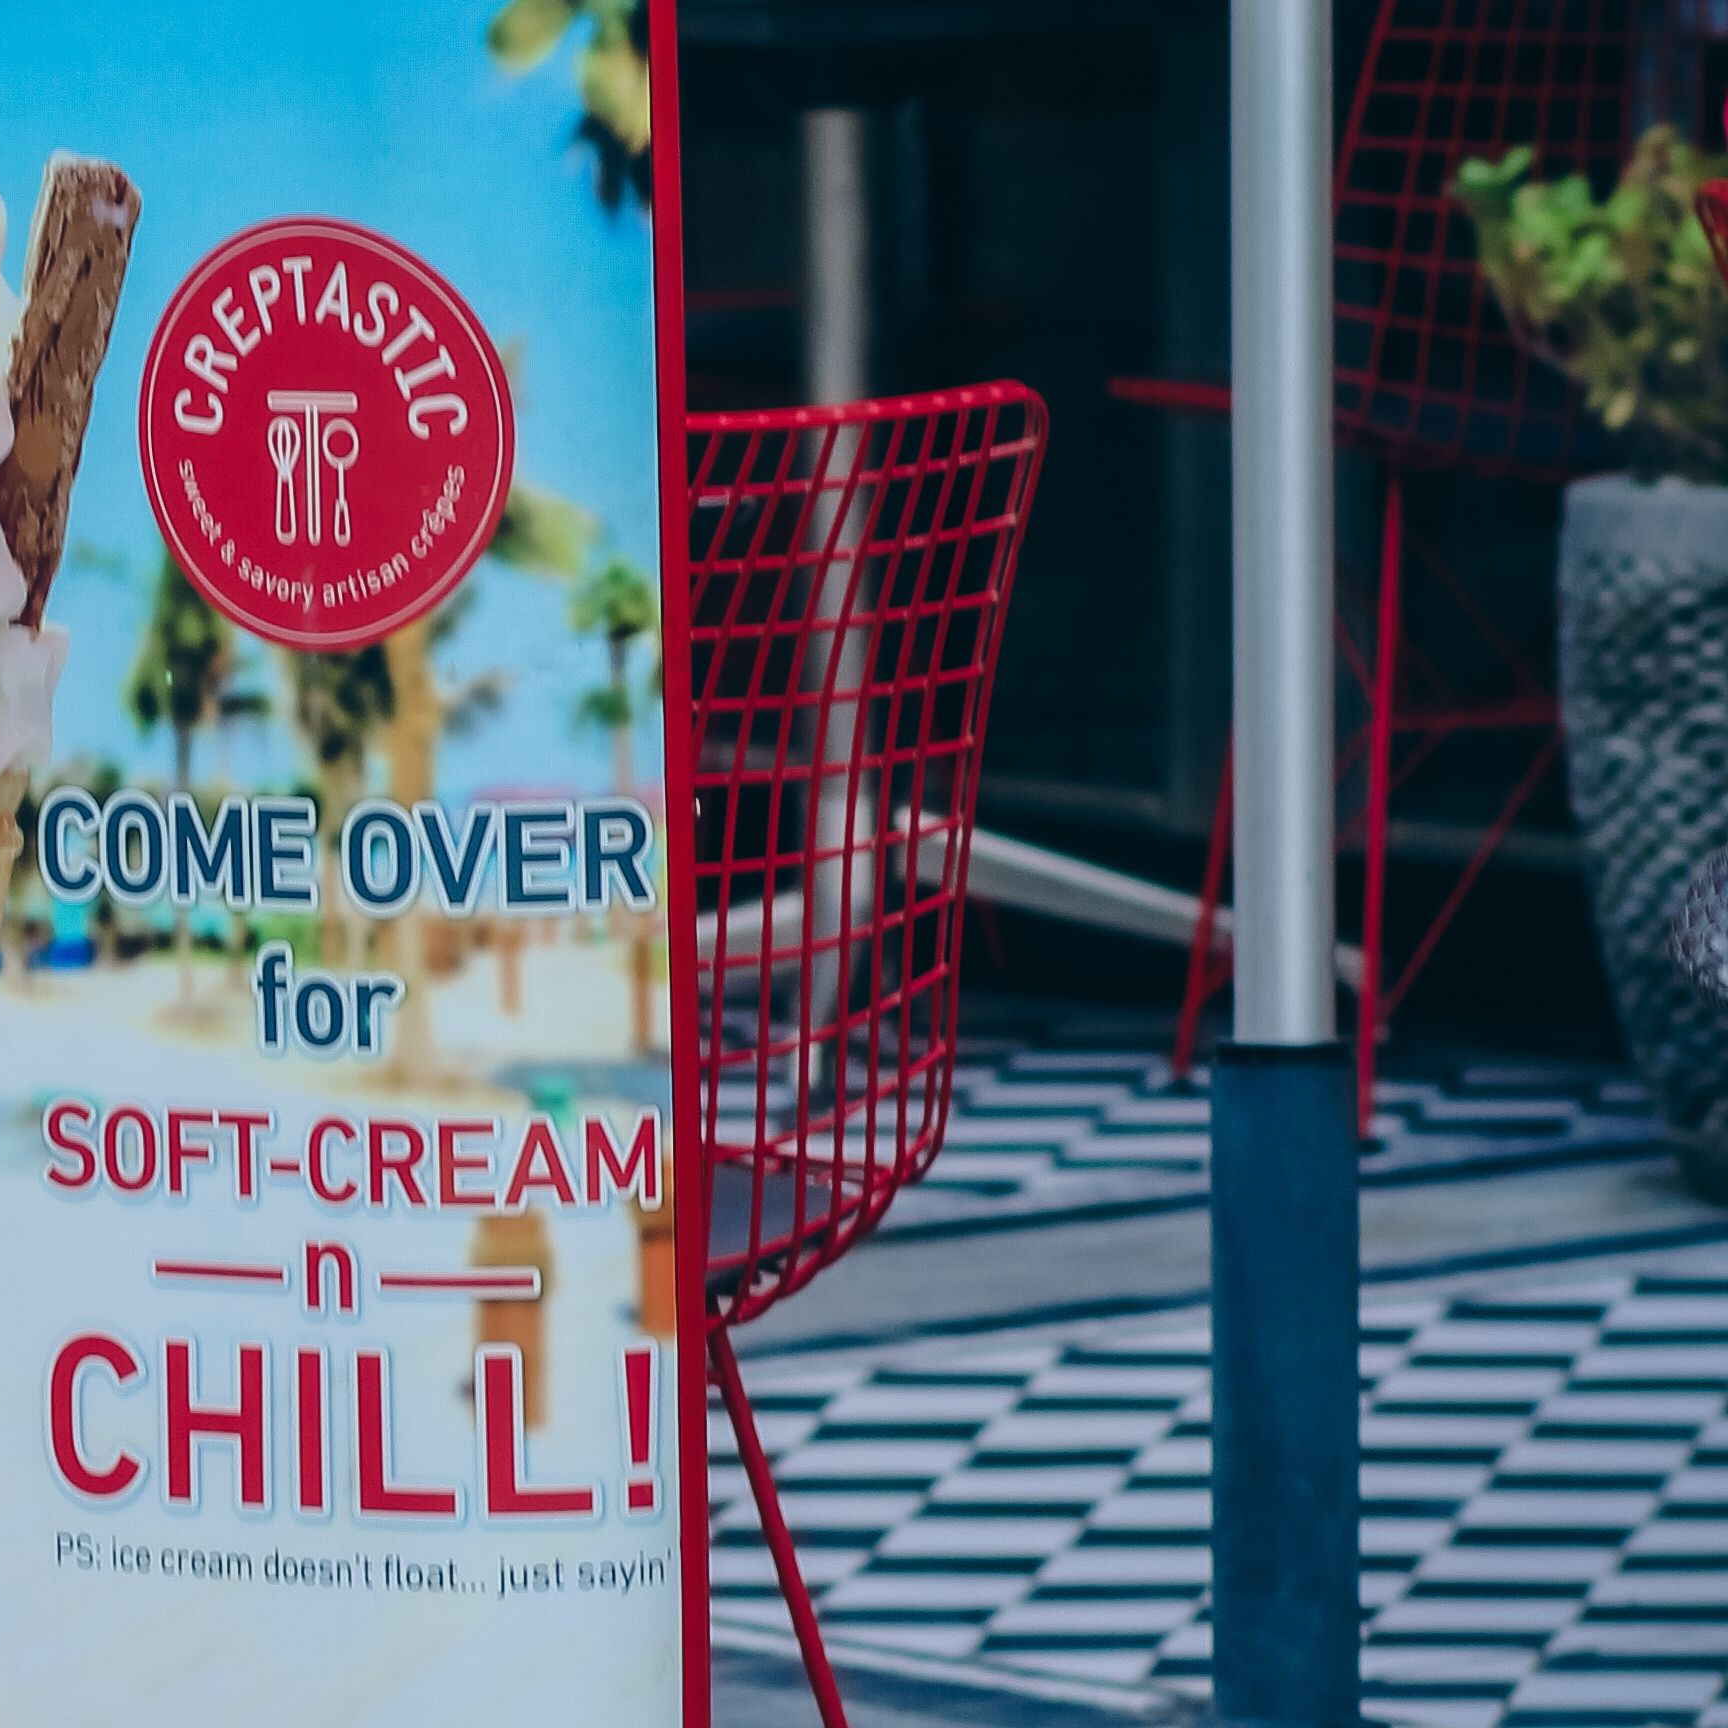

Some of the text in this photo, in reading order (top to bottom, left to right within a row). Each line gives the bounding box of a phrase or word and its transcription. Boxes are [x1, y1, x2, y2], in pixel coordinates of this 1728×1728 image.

[174, 256, 468, 440] CREPTASTIC
[178, 458, 222, 547] sweet
[220, 538, 236, 568] &
[237, 556, 315, 614] savory
[322, 552, 411, 608] artisan
[43, 796, 652, 908] COME OVER
[253, 948, 398, 1050] for
[46, 1104, 660, 1209] SOFT-CREAM
[49, 1334, 658, 1514] CHILL!
[56, 1530, 673, 1600] PS: ice cream doesn't float... just sayin'
